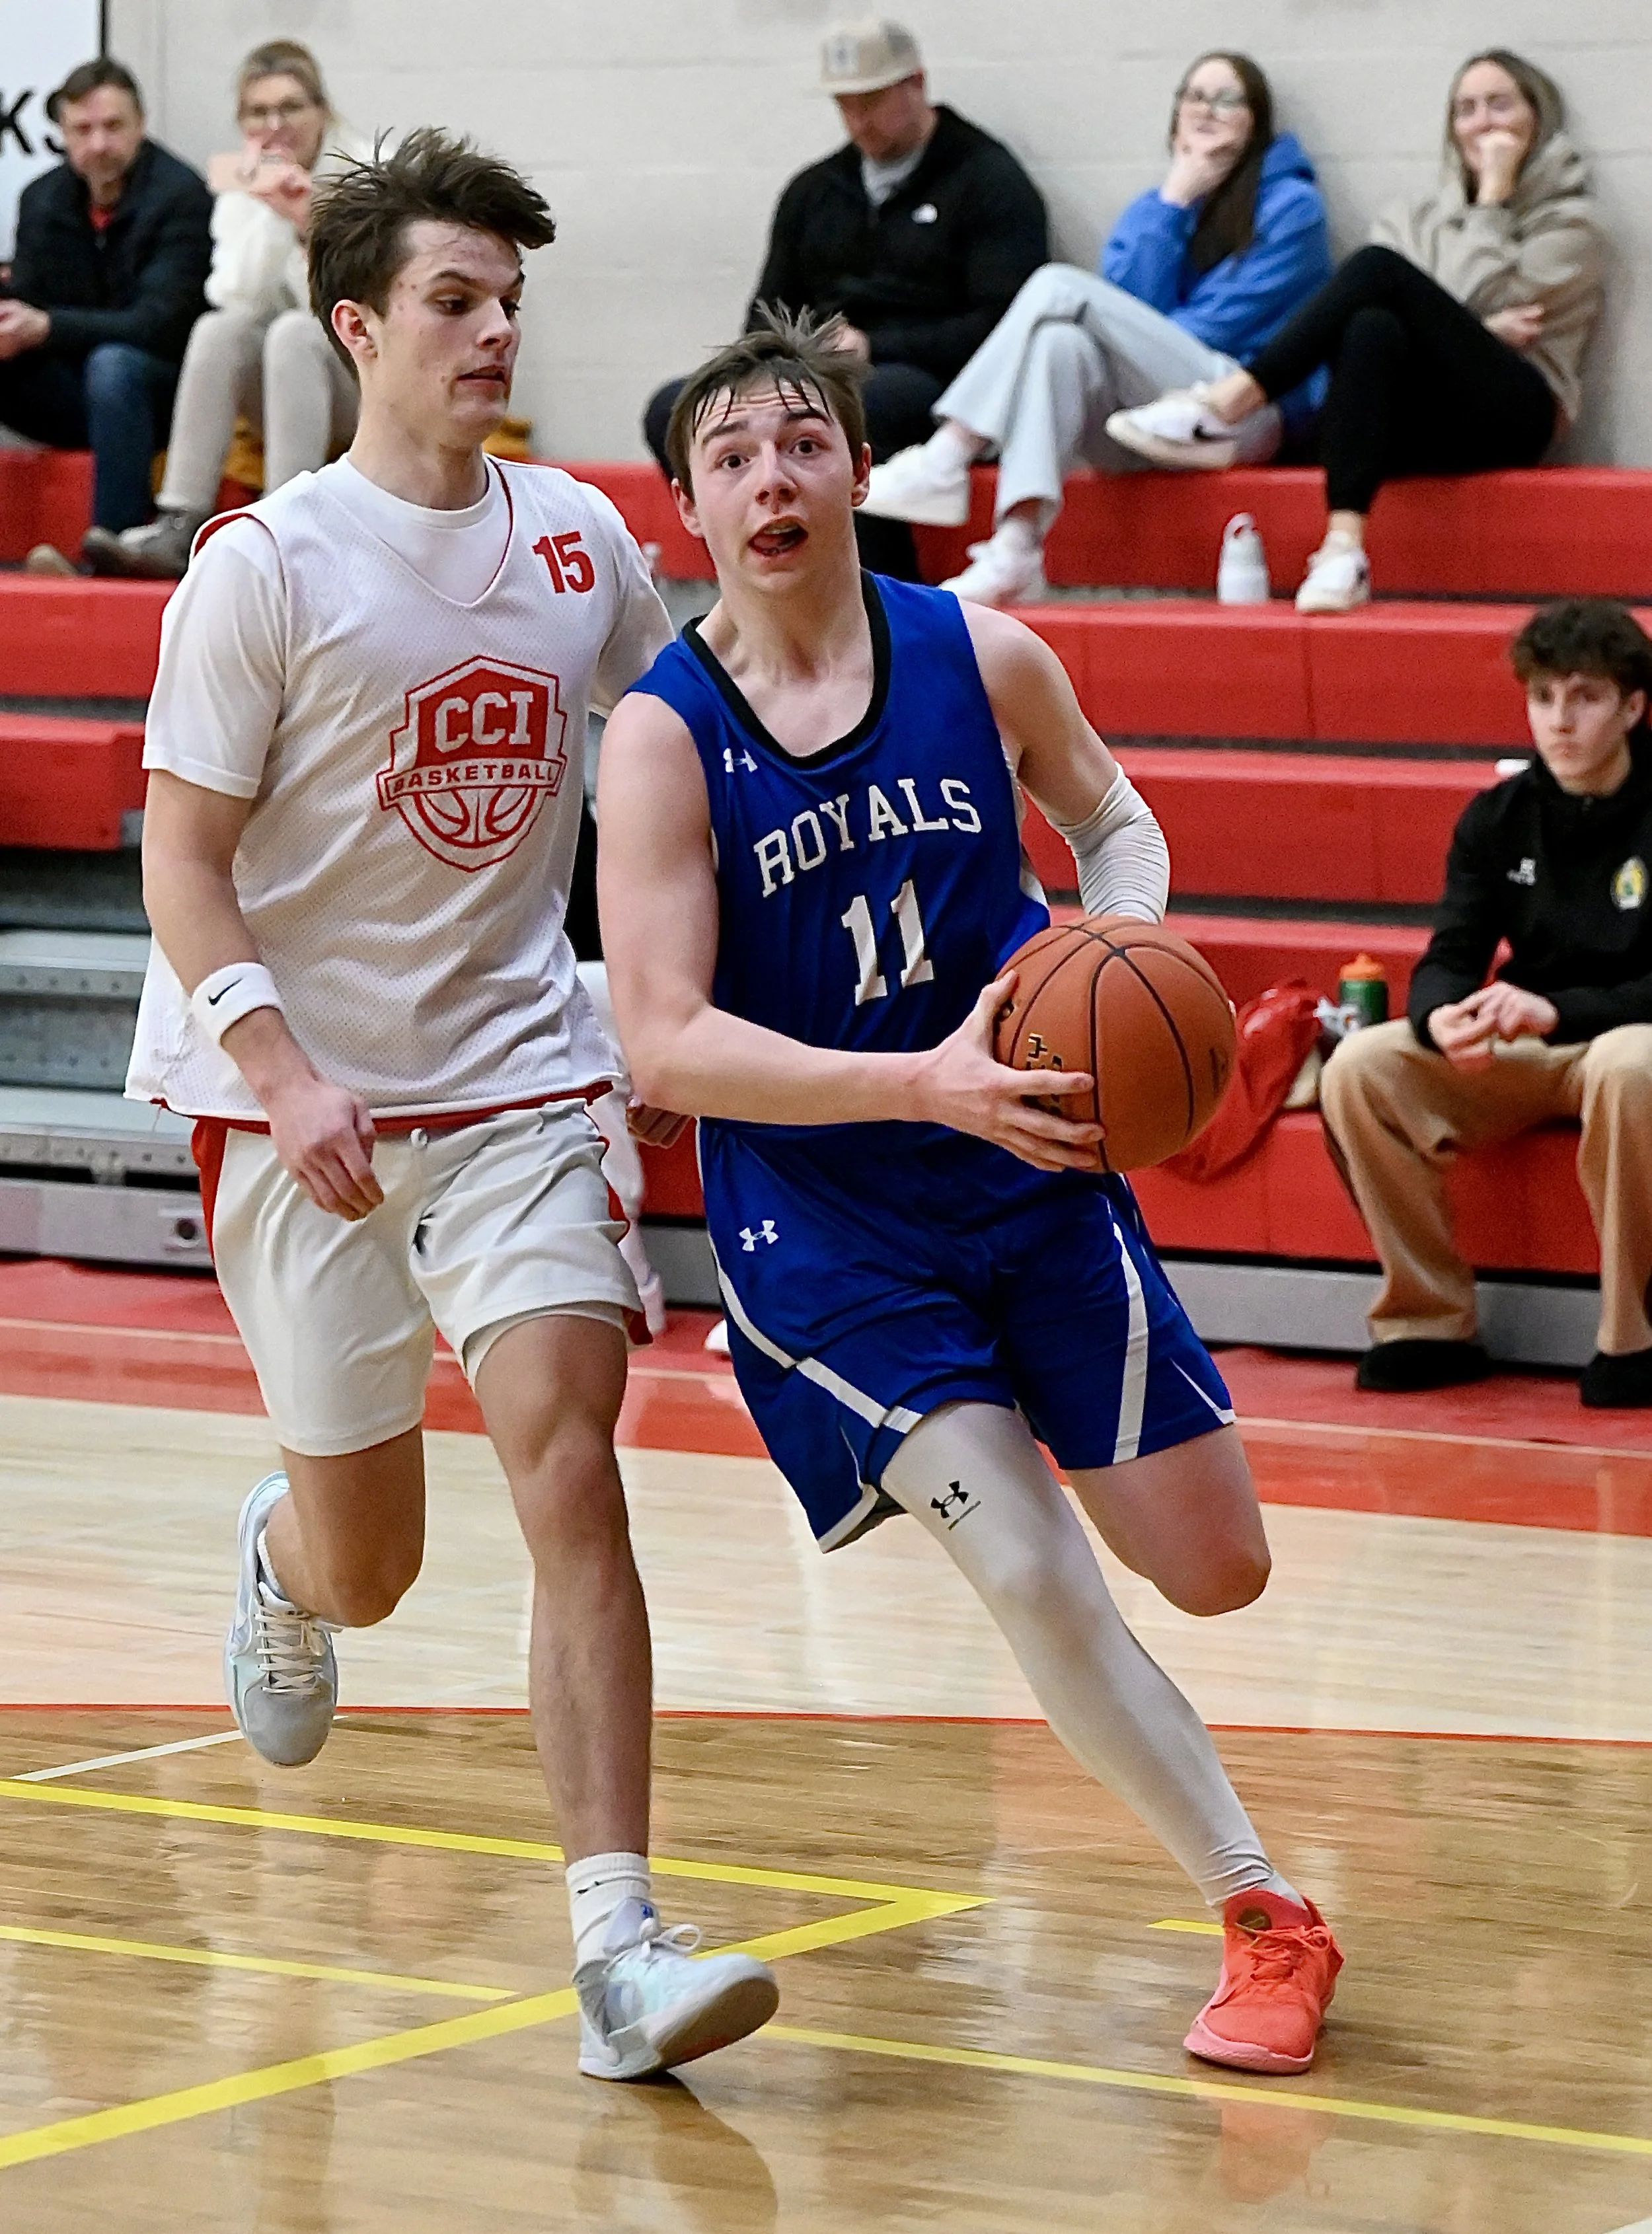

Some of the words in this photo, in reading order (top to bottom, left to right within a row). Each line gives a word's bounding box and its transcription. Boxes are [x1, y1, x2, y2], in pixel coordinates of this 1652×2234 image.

[531, 531, 595, 593] 15
[434, 690, 534, 753] CCI
[394, 764, 553, 792] BASKETBALL
[753, 778, 982, 898] ROYALS
[841, 878, 935, 1006] 11
